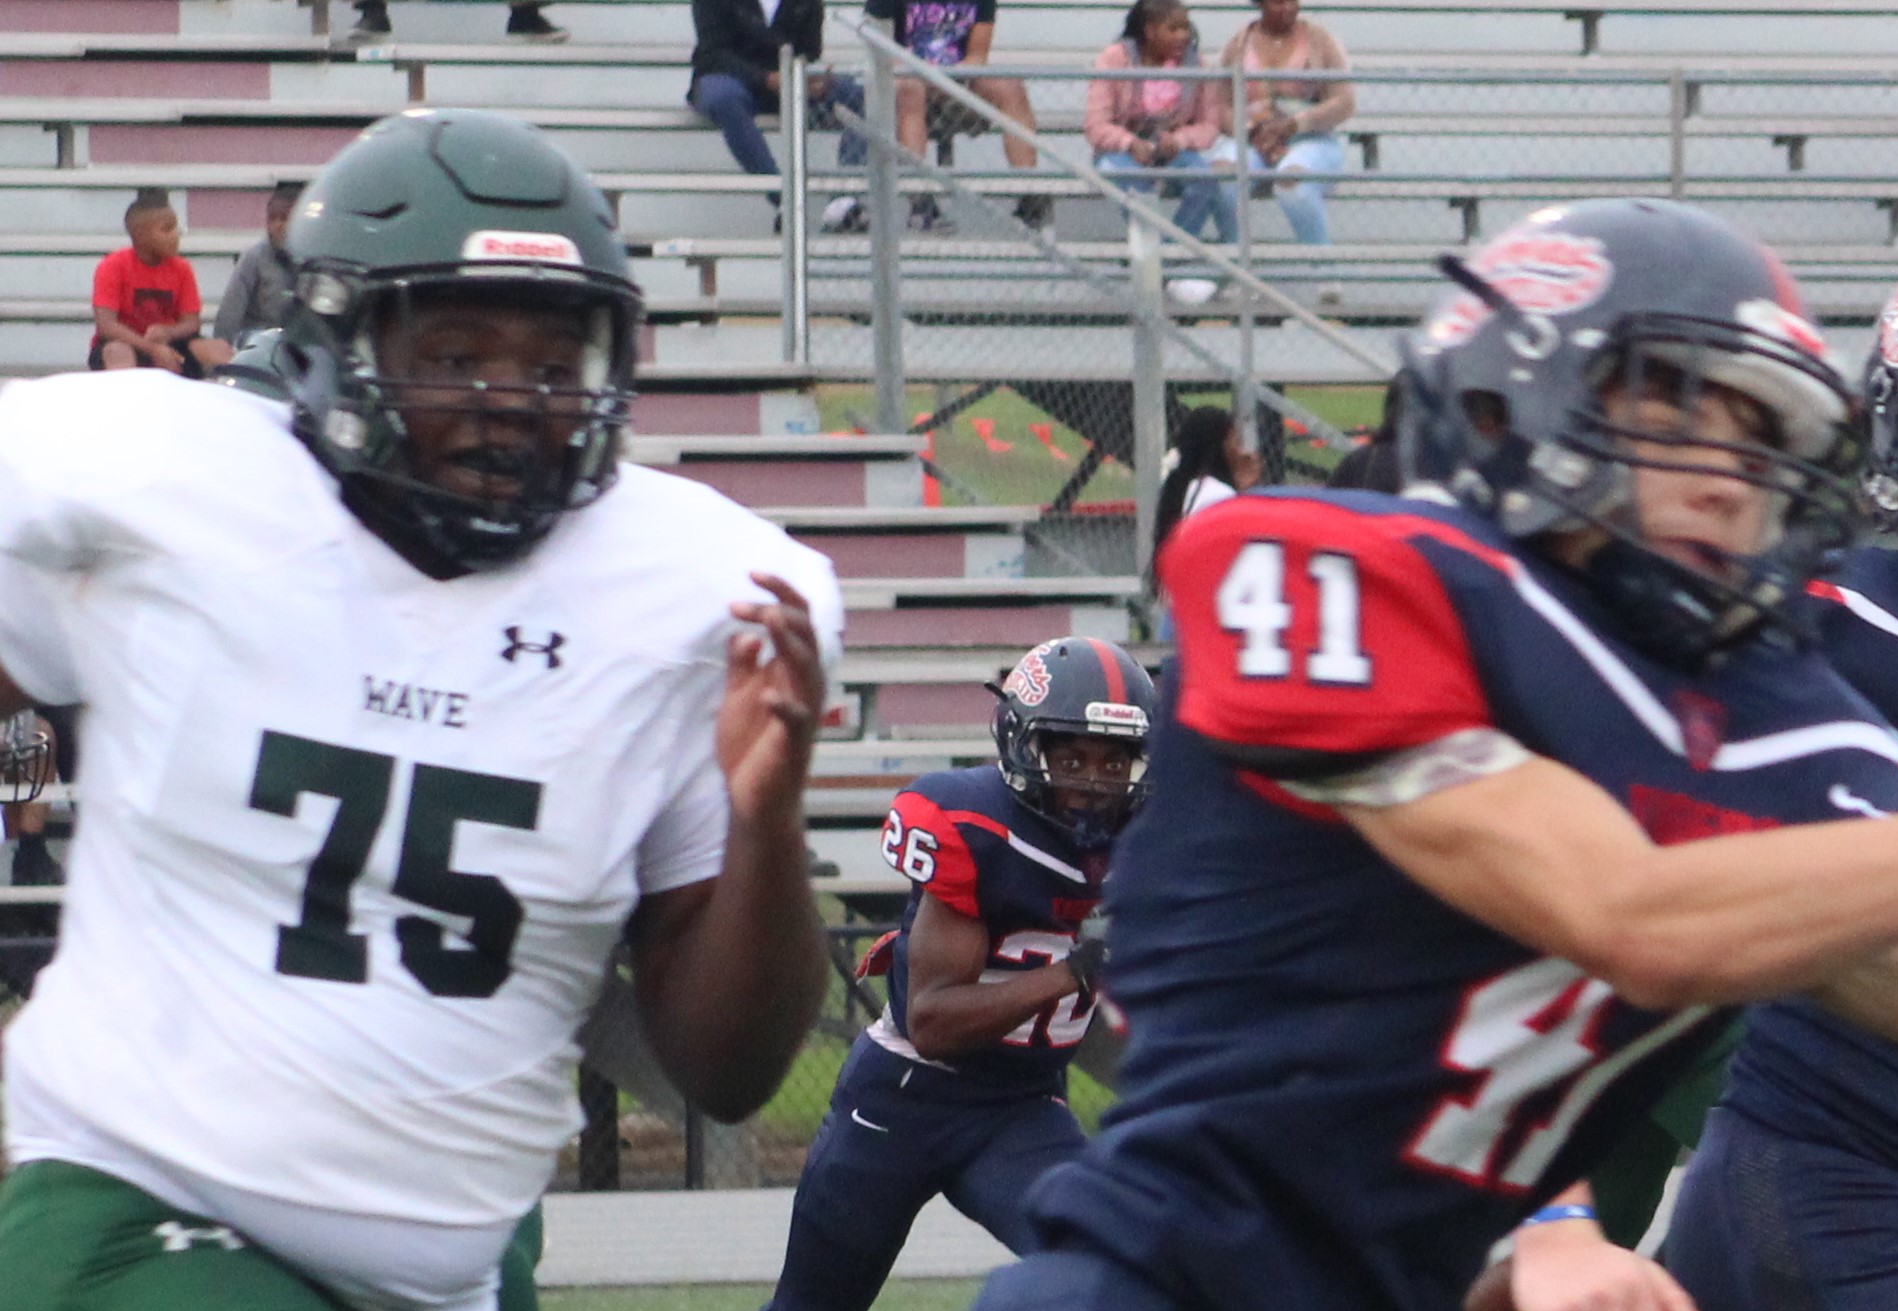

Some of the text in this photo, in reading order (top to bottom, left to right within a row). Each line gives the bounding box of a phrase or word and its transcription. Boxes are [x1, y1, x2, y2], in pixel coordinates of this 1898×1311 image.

[1216, 538, 1373, 687] 41
[363, 674, 468, 728] WAVE
[249, 728, 542, 997] 75
[882, 809, 938, 883] 26
